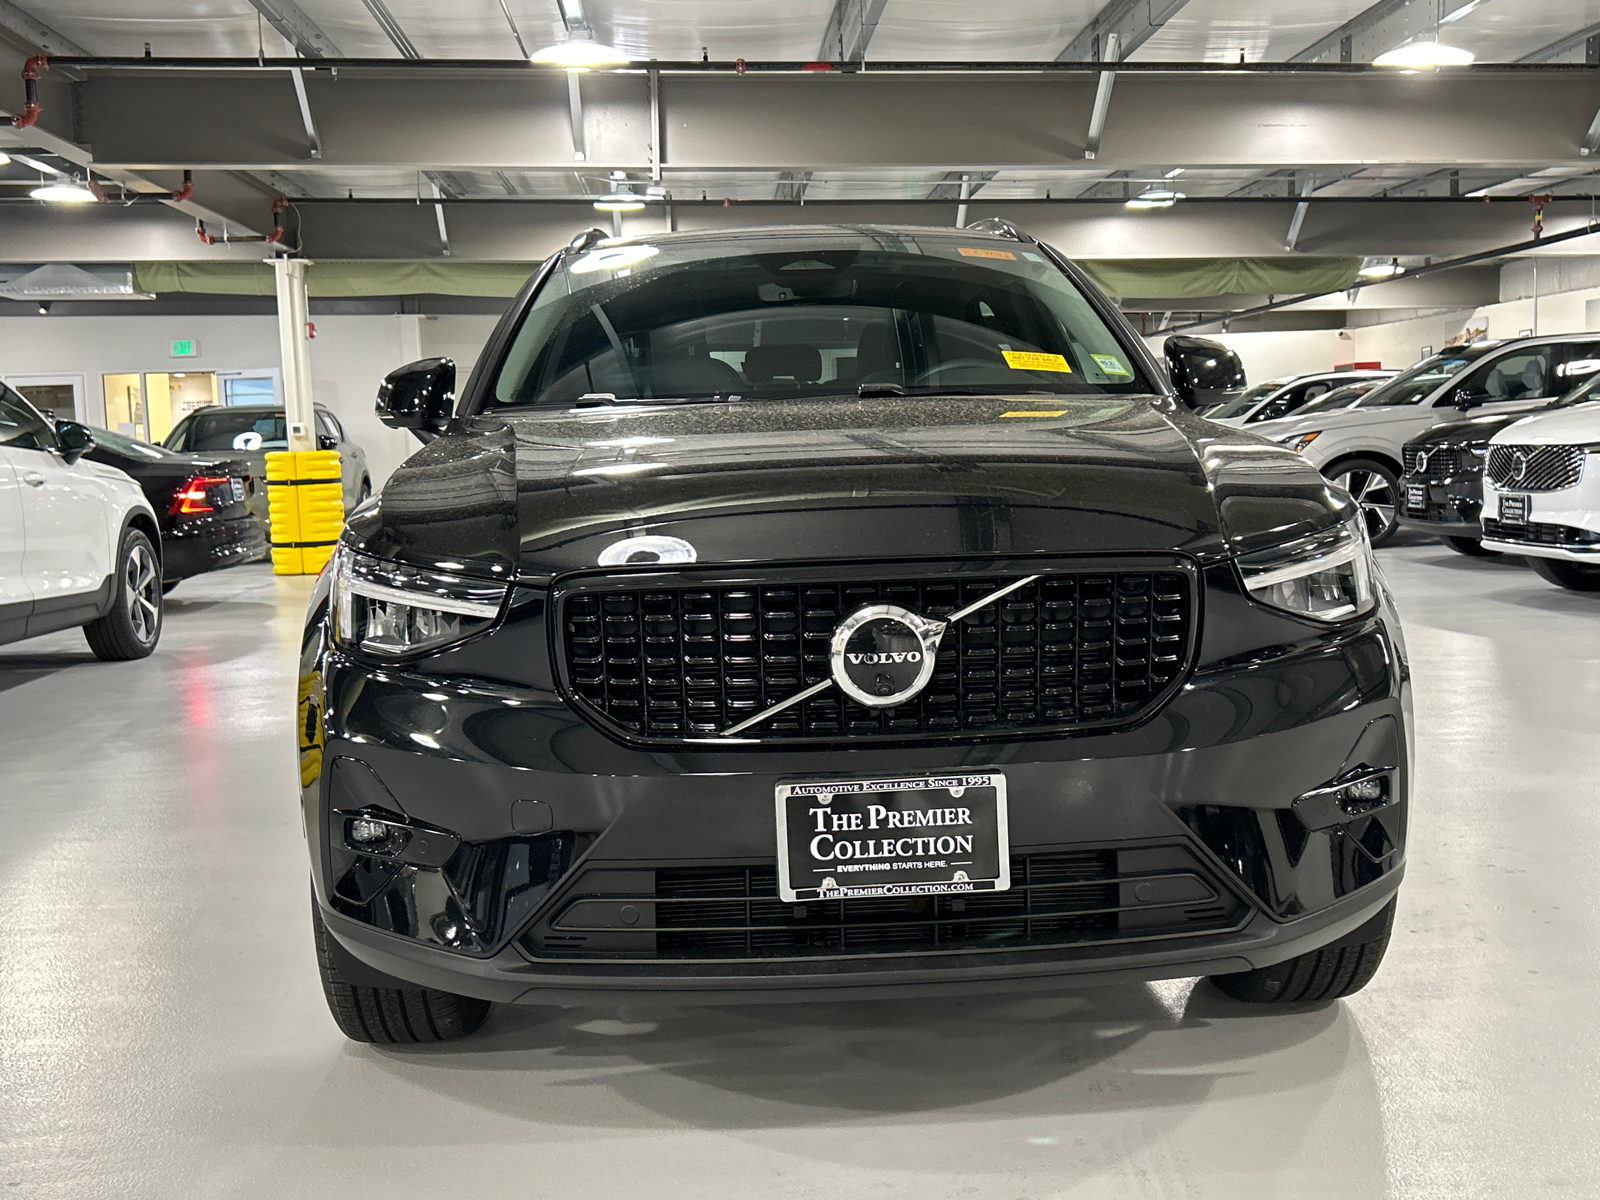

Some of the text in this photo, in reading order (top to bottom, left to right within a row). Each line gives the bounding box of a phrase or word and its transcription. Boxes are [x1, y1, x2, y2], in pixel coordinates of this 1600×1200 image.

[173, 341, 191, 355] EXIT
[846, 651, 921, 665] VOLVO
[793, 776, 990, 795] AUTOMOTIVE EXCELLENCE SINCE 1995
[809, 804, 973, 832] THE PREMIER
[810, 834, 973, 861] COLLECTION
[837, 860, 948, 873] EVERYTHING STARTS HERE.
[817, 883, 974, 898] THEPREMIERCOLLECTION.COM
